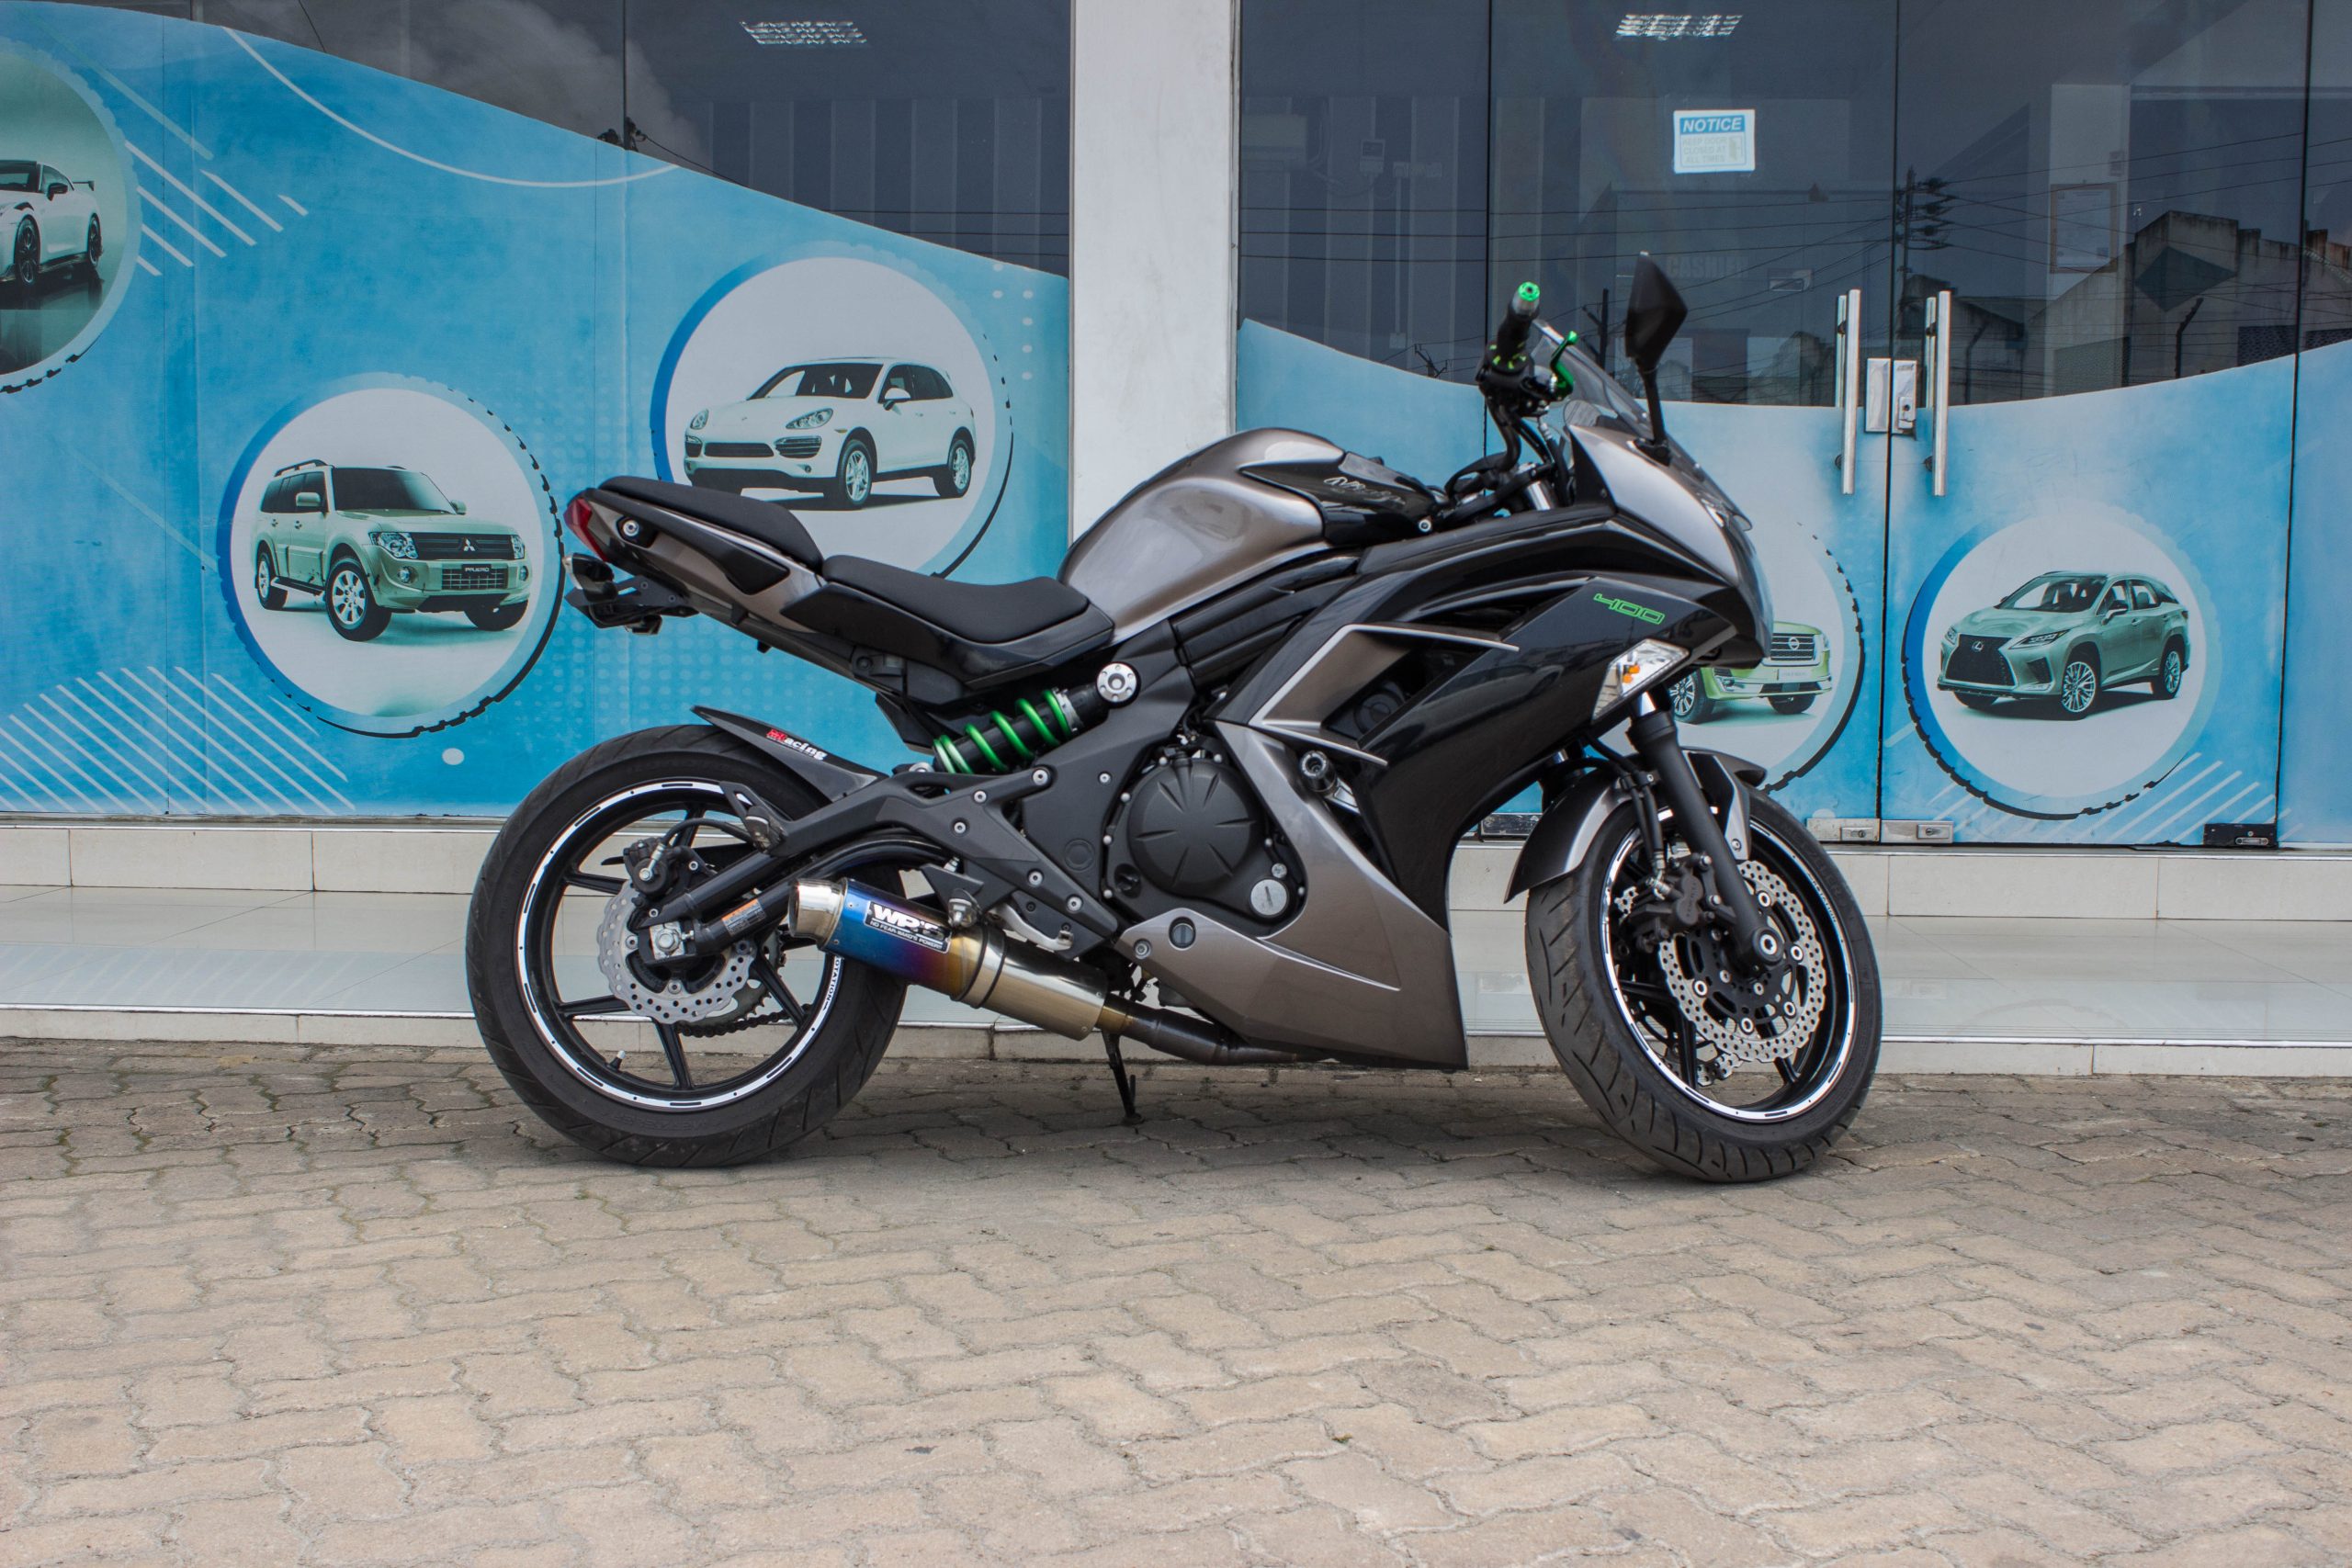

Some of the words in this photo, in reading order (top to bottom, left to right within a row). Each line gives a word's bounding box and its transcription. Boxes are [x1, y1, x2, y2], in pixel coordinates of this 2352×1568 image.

[1683, 117, 1743, 133] NOTICE
[1592, 592, 1666, 625] 400
[826, 956, 841, 1001] OTATION
